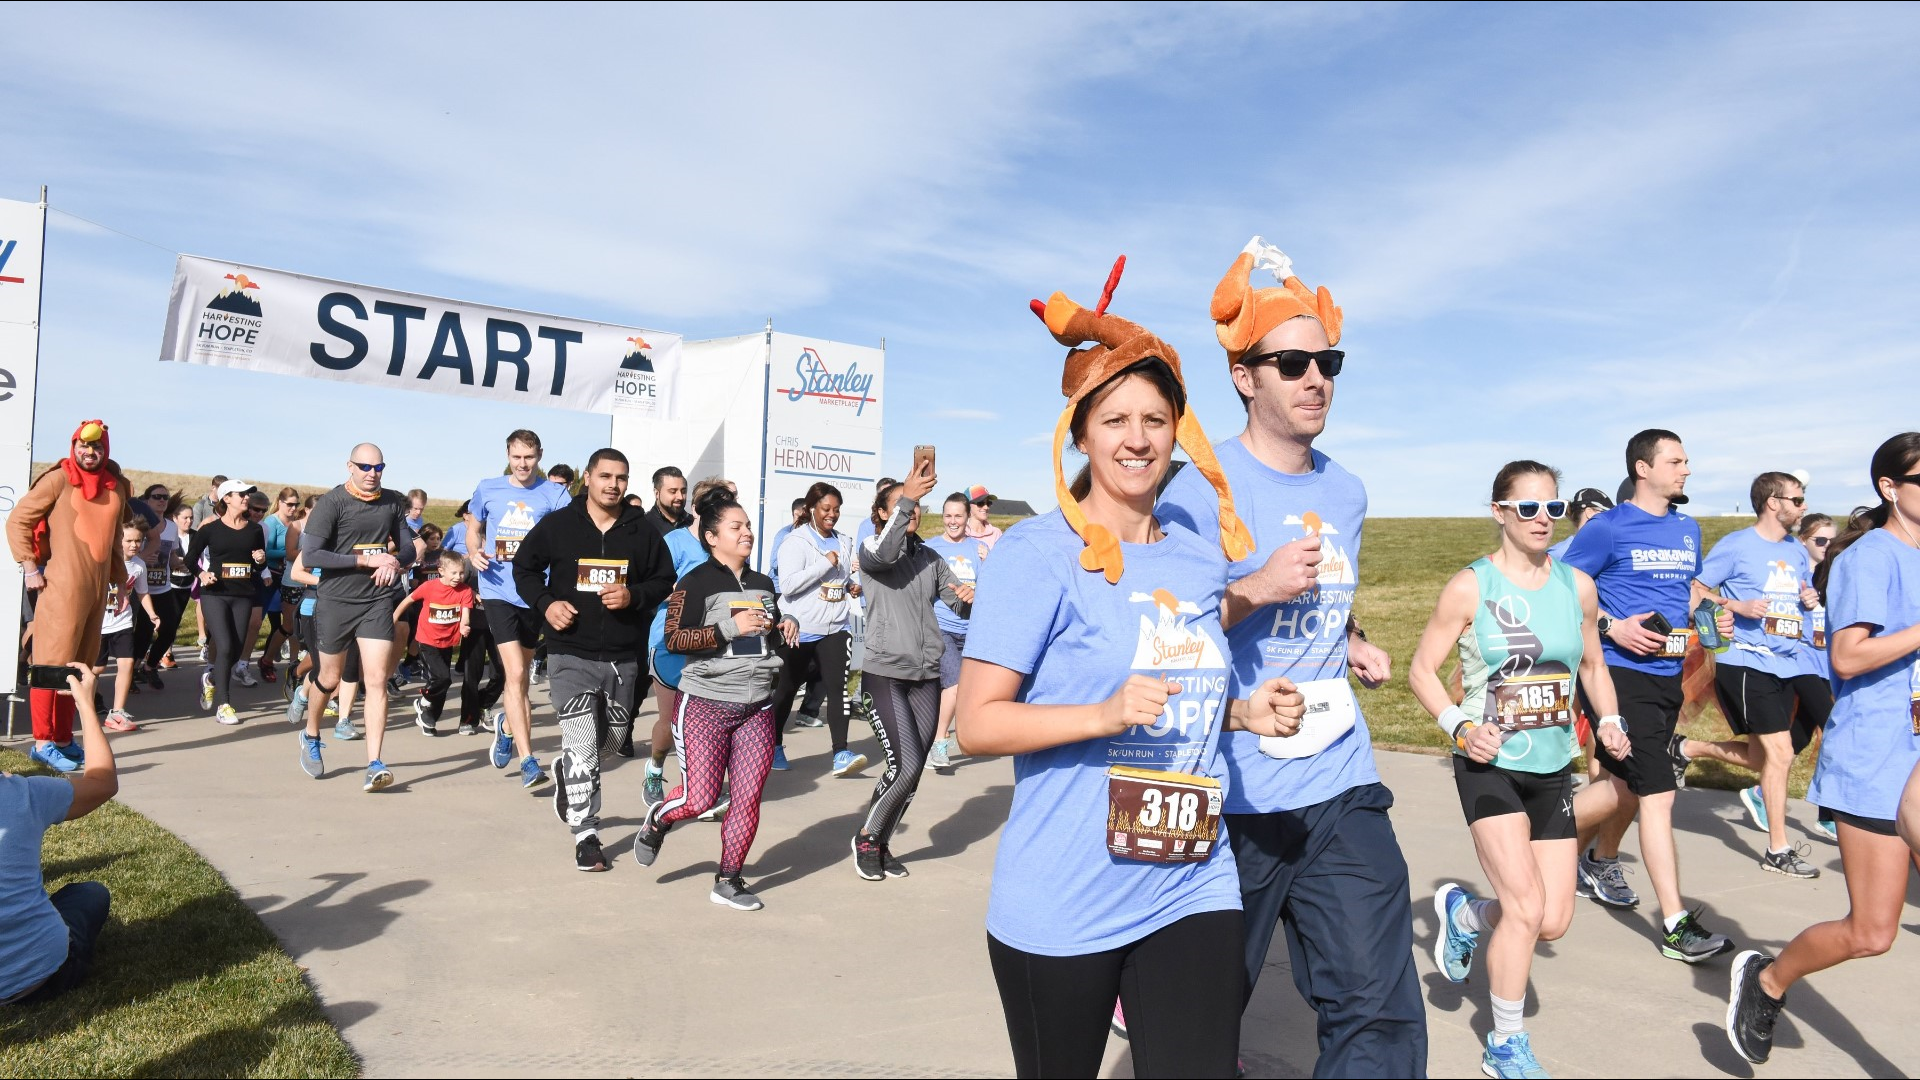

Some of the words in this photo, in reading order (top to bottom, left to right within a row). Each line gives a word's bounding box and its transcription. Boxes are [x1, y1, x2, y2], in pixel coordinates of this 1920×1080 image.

[202, 311, 262, 328] HARVESTING
[198, 322, 259, 345] HOPE
[309, 291, 583, 396] START
[617, 371, 656, 382] HARVESTING
[788, 352, 874, 417] Stanley
[614, 379, 656, 397] HOPE
[819, 398, 859, 408] MARKETPLACE
[775, 435, 799, 448] CHRIS
[774, 448, 851, 473] HERNDON
[505, 541, 521, 554] 52
[1631, 549, 1696, 567] Breakaway
[229, 567, 246, 577] 625
[589, 568, 616, 584] 863
[827, 588, 843, 599] 698
[435, 609, 453, 619] 844
[665, 590, 686, 634] NEW
[1776, 618, 1799, 636] 650
[1153, 635, 1205, 669] Stanley
[1665, 635, 1685, 654] 660
[1517, 684, 1556, 709] 185
[1135, 749, 1154, 758] RUN
[1138, 788, 1199, 832] 318
